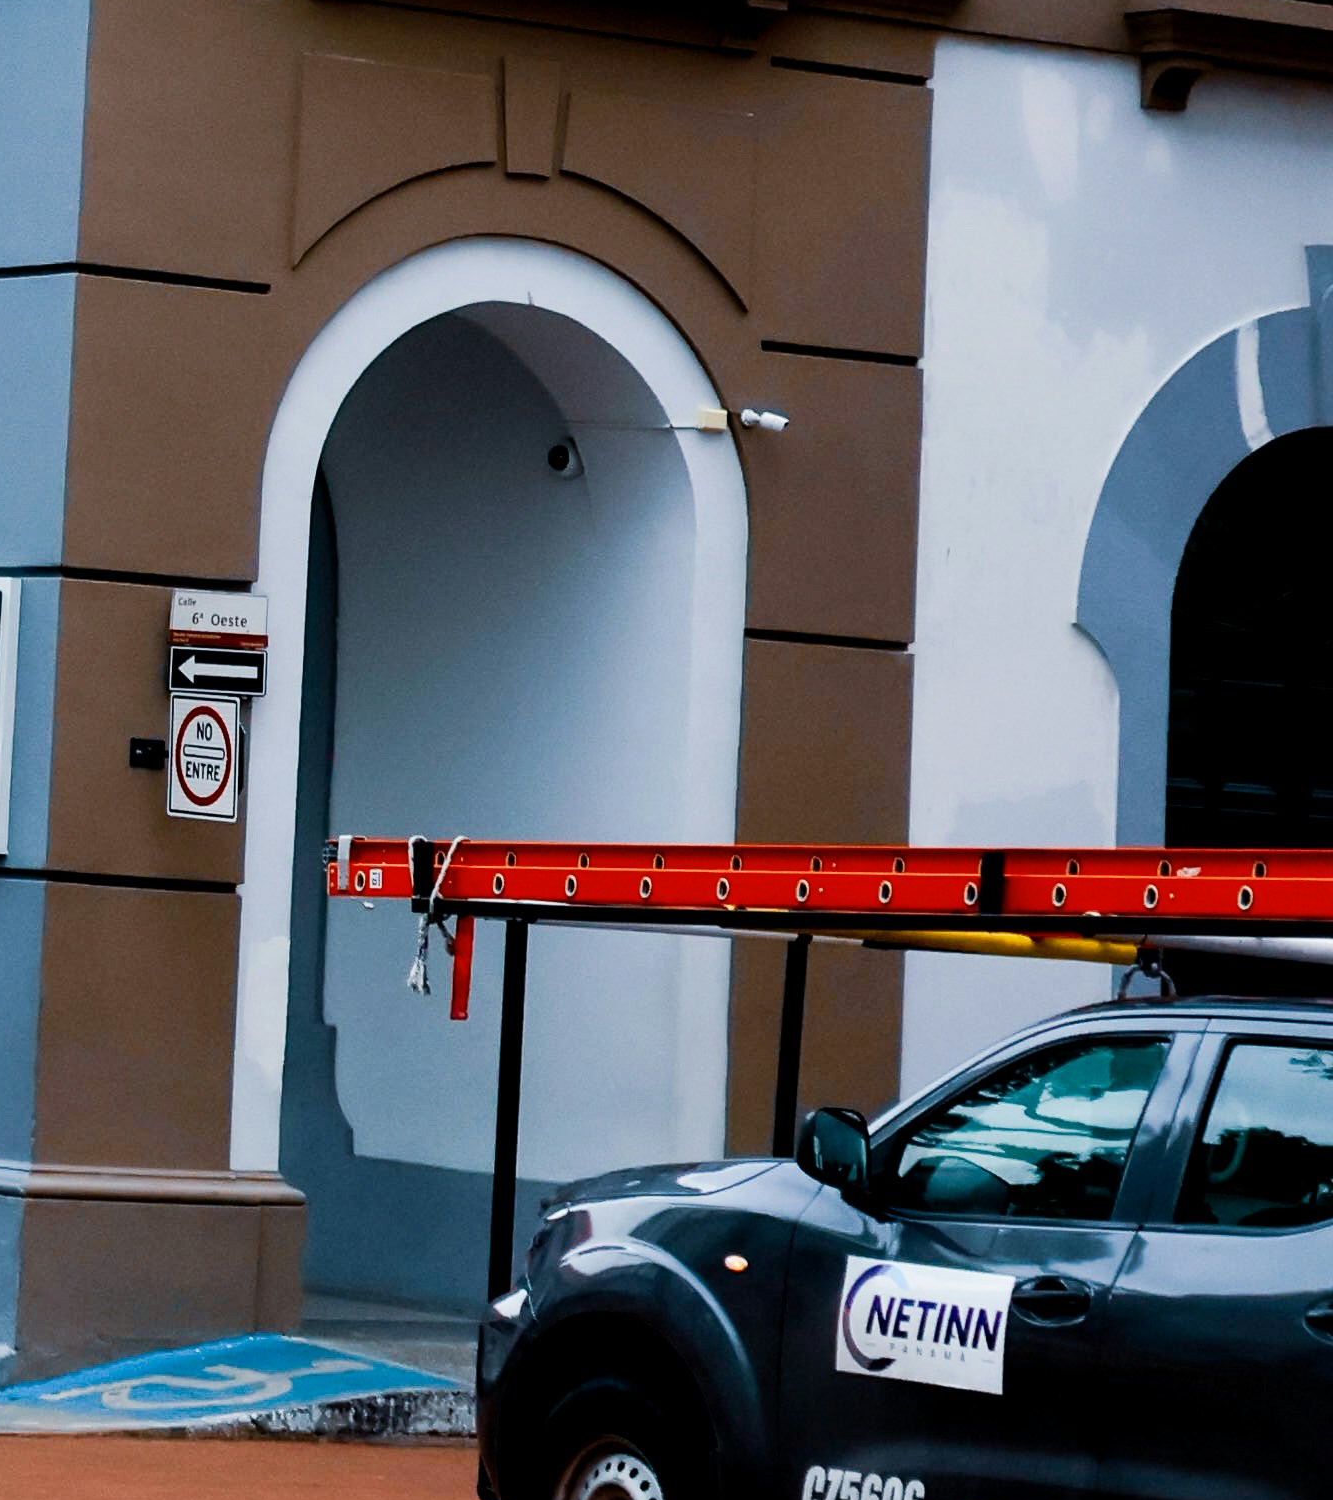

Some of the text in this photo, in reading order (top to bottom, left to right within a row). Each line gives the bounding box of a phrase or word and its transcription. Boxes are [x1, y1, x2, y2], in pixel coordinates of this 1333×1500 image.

[210, 613, 249, 628] Oeste
[196, 722, 214, 742] NO
[185, 761, 221, 782] ENTRE
[865, 1294, 1004, 1353] NETINN
